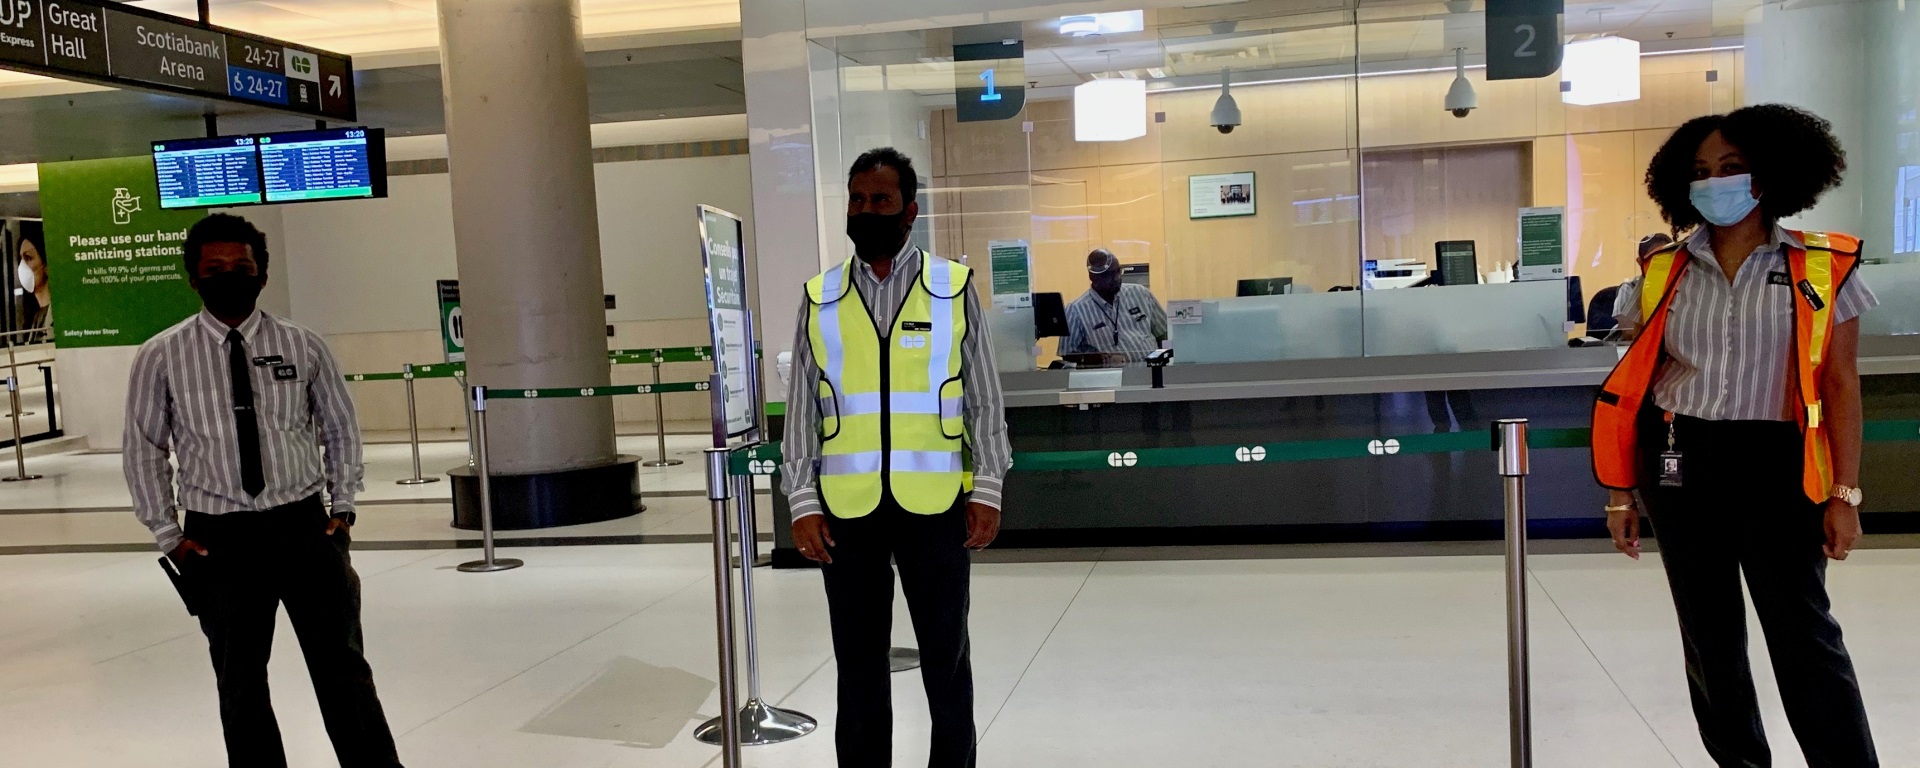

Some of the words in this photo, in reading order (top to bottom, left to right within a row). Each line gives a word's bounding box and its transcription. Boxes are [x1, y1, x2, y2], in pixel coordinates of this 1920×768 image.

[48, 3, 98, 33] Great
[0, 32, 35, 48] Express
[51, 33, 87, 60] Hall
[136, 25, 221, 60] Scotiabank
[1513, 23, 1537, 58] 2
[160, 56, 205, 81] Arena
[244, 45, 280, 69] 24-27
[247, 75, 283, 99] 24-27
[979, 68, 1001, 101] 1
[69, 234, 108, 247] Please
[111, 234, 132, 245] use
[135, 232, 155, 243] our
[157, 228, 188, 241] hand
[74, 246, 132, 261] sanitizing
[135, 245, 185, 258] stations.
[82, 276, 99, 285] finds
[101, 275, 119, 284] 100%
[121, 274, 128, 282] of
[129, 275, 145, 283] your
[94, 266, 107, 275] kills
[108, 265, 129, 274] 99.9%
[130, 264, 138, 273] of
[139, 265, 161, 274] germs
[162, 263, 176, 272] and
[63, 329, 83, 337] Safety
